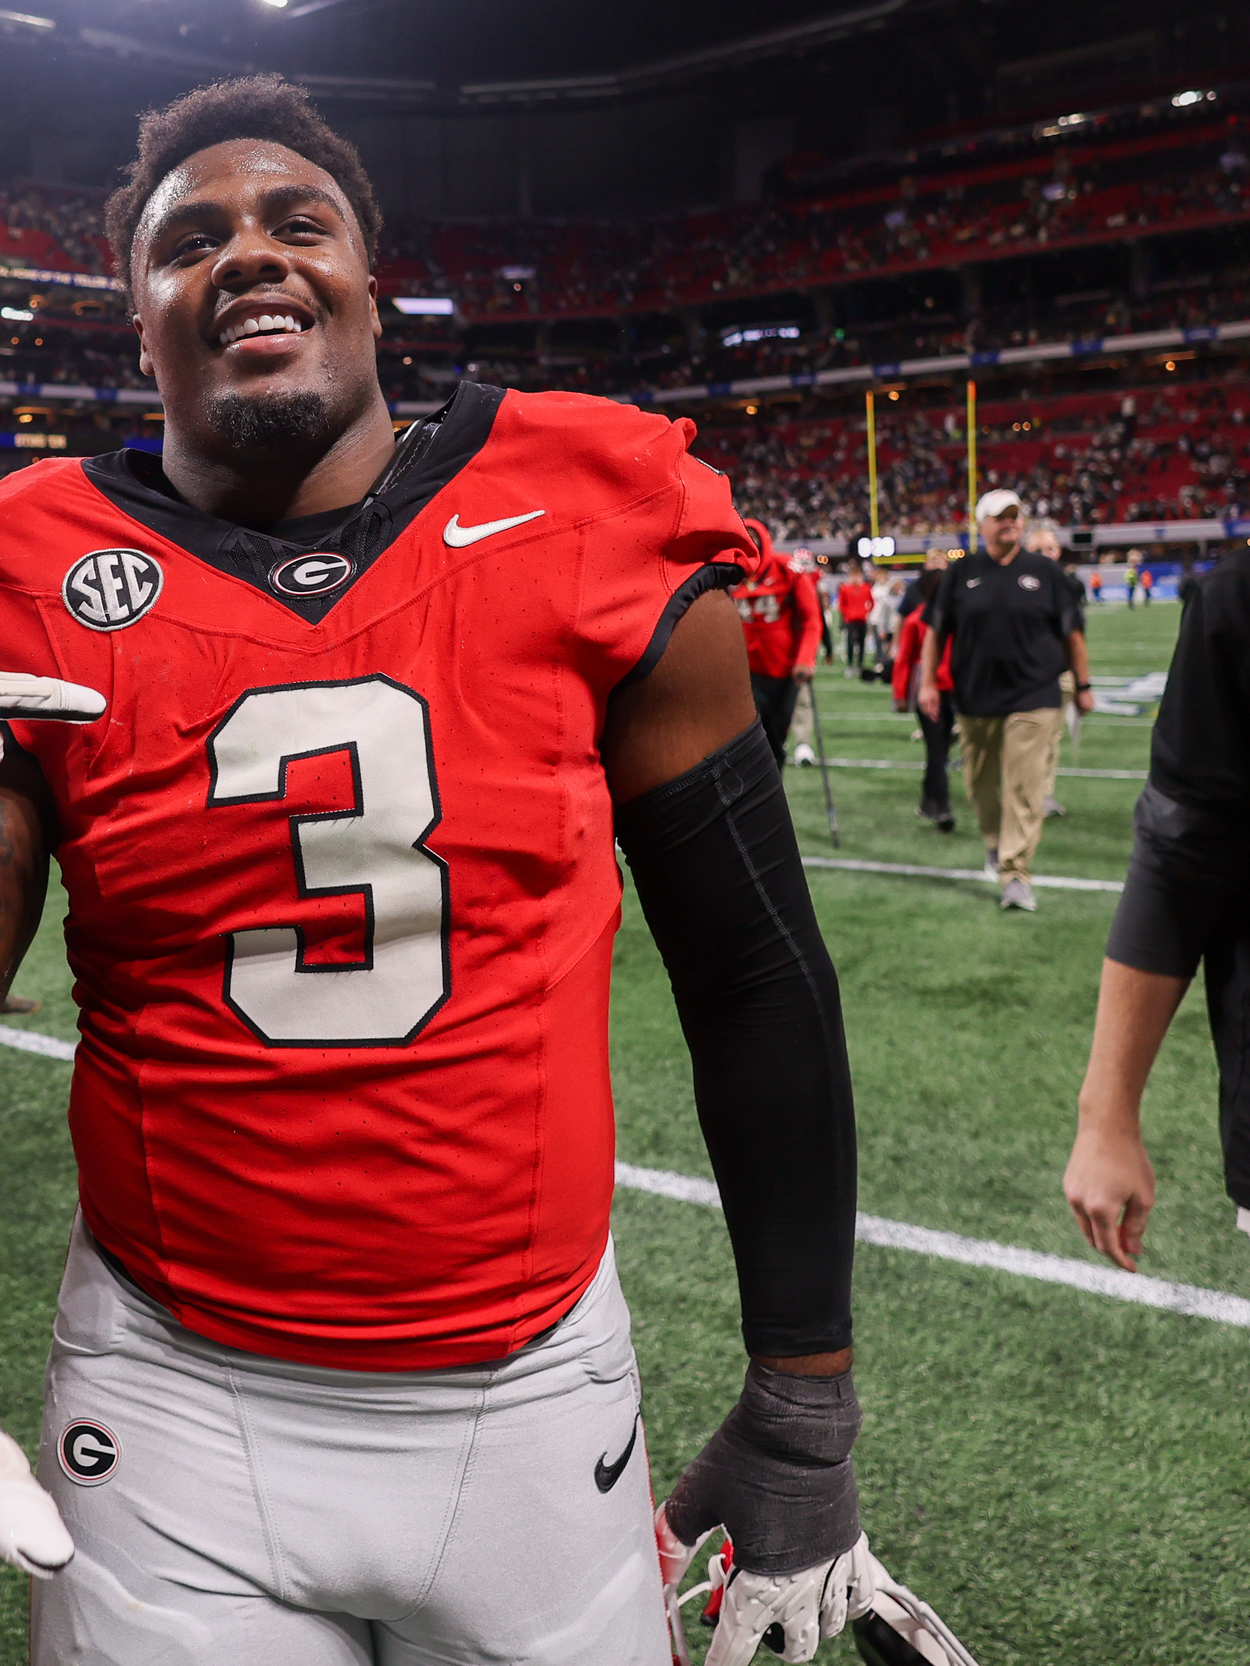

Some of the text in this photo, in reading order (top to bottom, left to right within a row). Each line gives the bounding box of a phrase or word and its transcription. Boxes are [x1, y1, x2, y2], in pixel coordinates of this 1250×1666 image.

[70, 552, 154, 624] SEC
[207, 672, 451, 1048] 3
[62, 1424, 117, 1477] G
